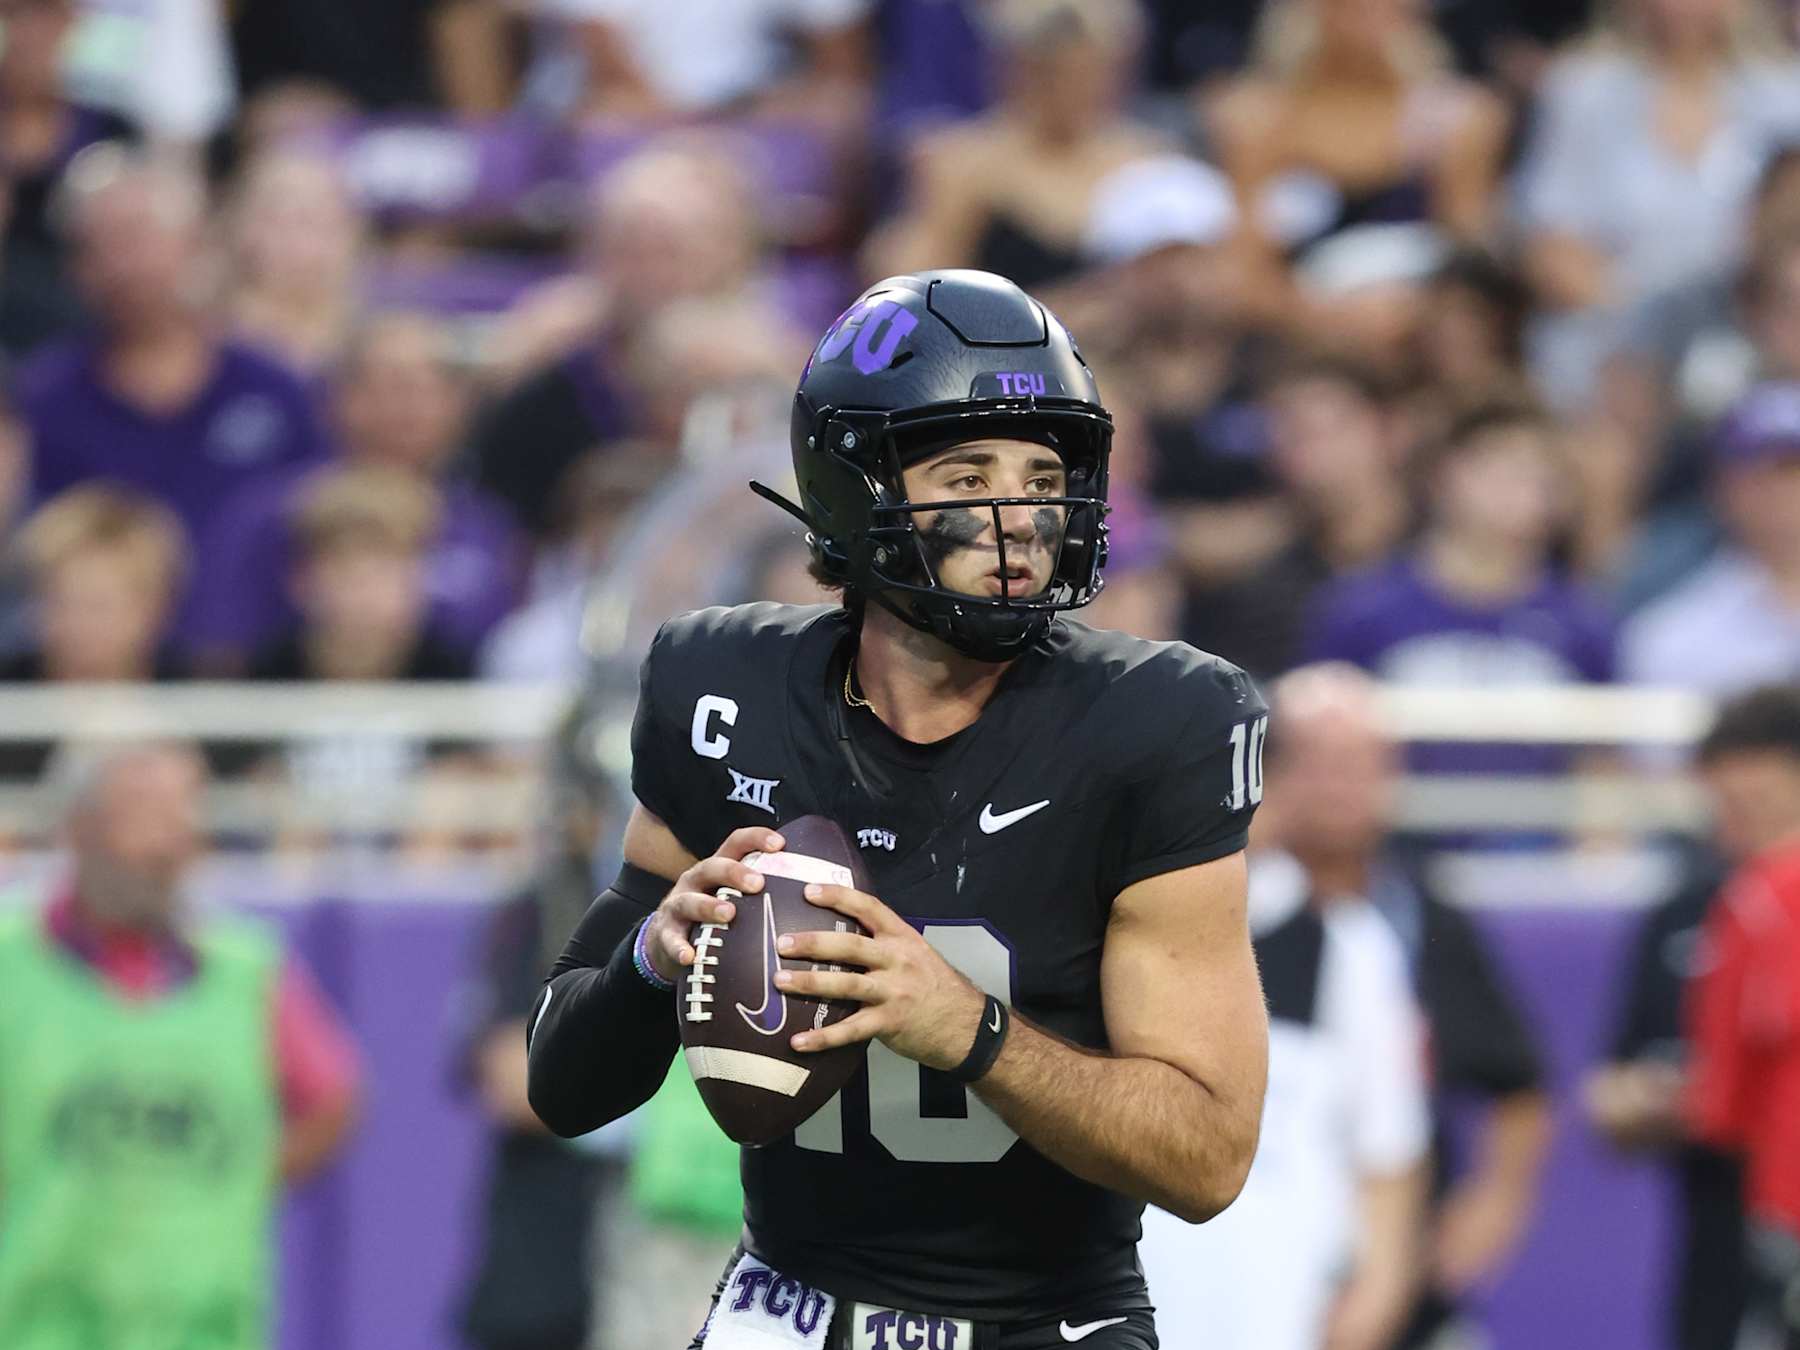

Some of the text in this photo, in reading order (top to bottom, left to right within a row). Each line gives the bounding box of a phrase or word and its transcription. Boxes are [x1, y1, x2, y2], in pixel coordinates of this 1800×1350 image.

[996, 373, 1046, 395] TCU
[691, 694, 739, 760] C
[726, 767, 780, 814] XII
[856, 827, 896, 852] TCU
[731, 1267, 828, 1337] TCU
